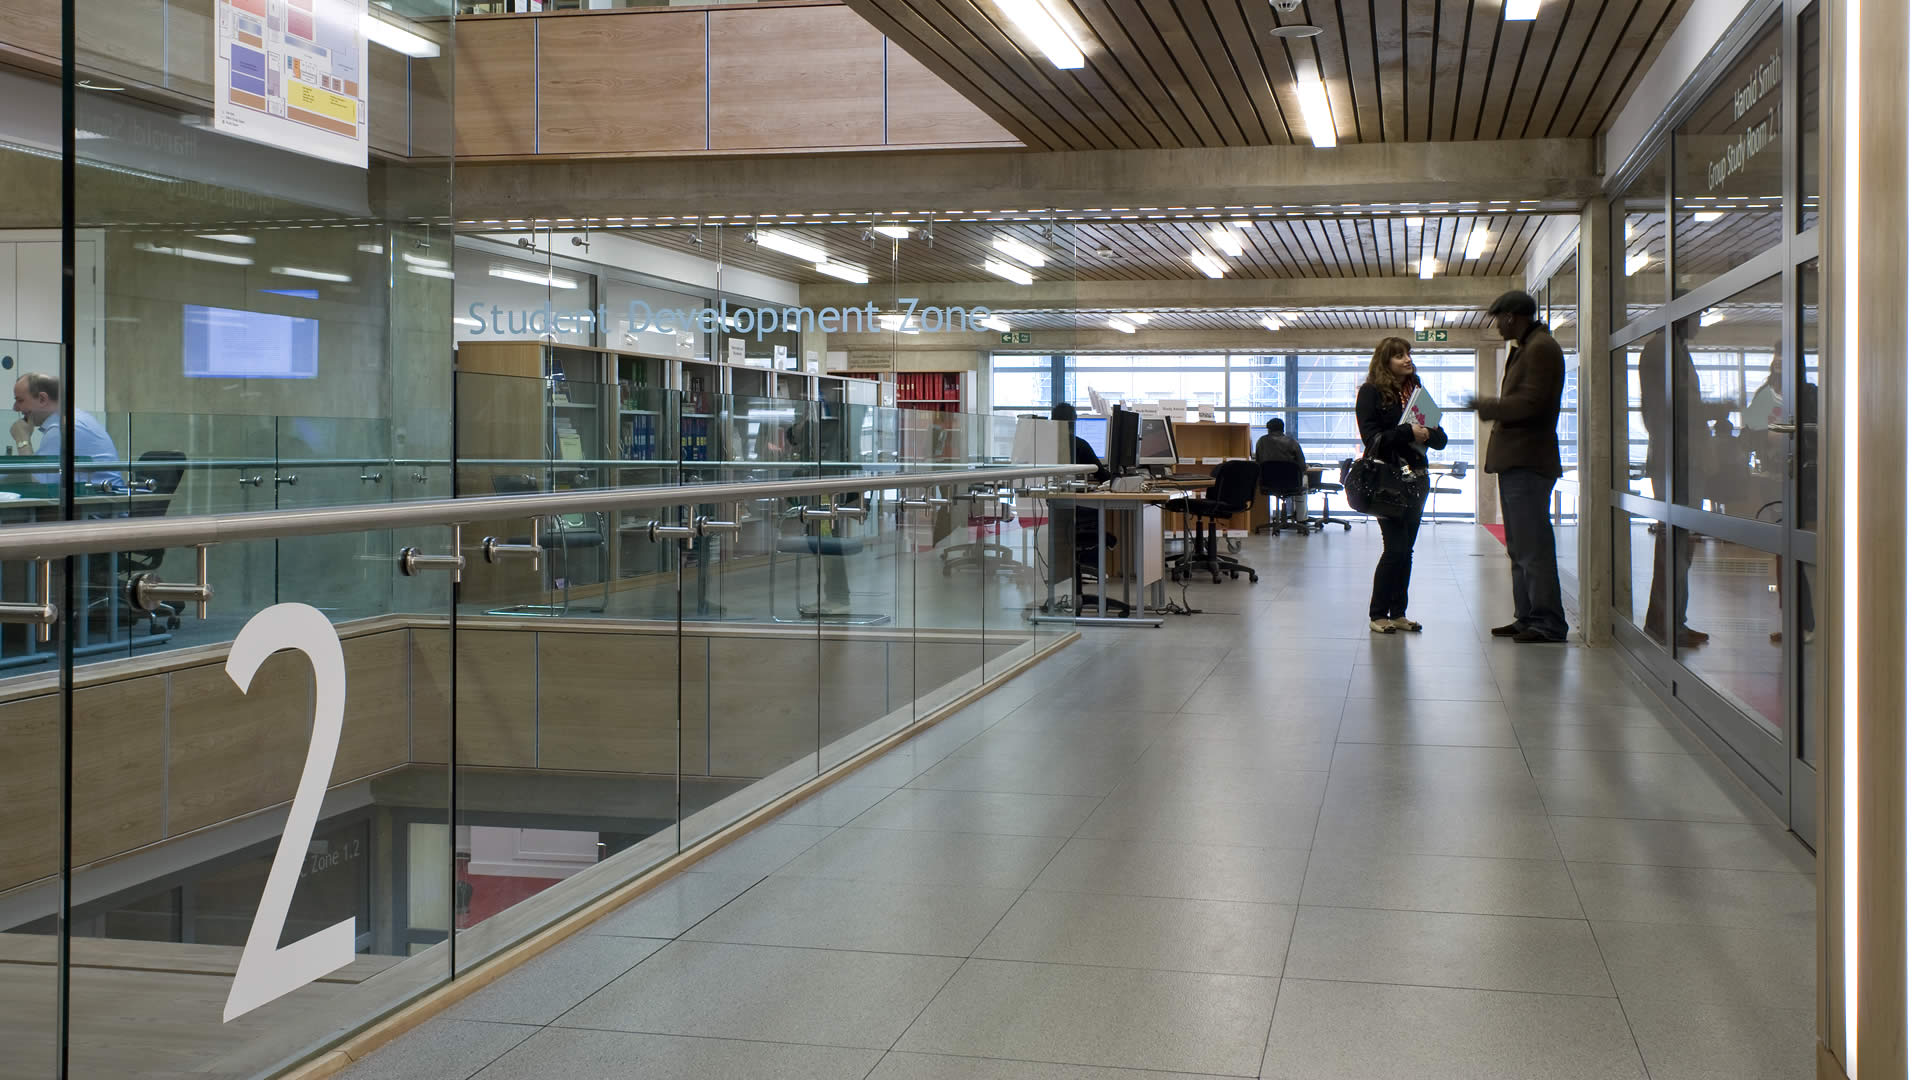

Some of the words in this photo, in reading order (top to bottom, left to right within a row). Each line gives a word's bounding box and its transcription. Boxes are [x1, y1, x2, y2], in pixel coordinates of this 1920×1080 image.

[1734, 69, 1757, 121] Harold
[1758, 47, 1781, 98] Smith
[1708, 156, 1727, 191] Group
[1727, 133, 1745, 173] Study
[1746, 119, 1767, 160] Room
[469, 300, 612, 335] Student
[628, 298, 880, 342] Development
[898, 298, 991, 333] Zone
[222, 602, 356, 1024] 2
[311, 850, 340, 873] Zone
[344, 839, 360, 861] 1.2
